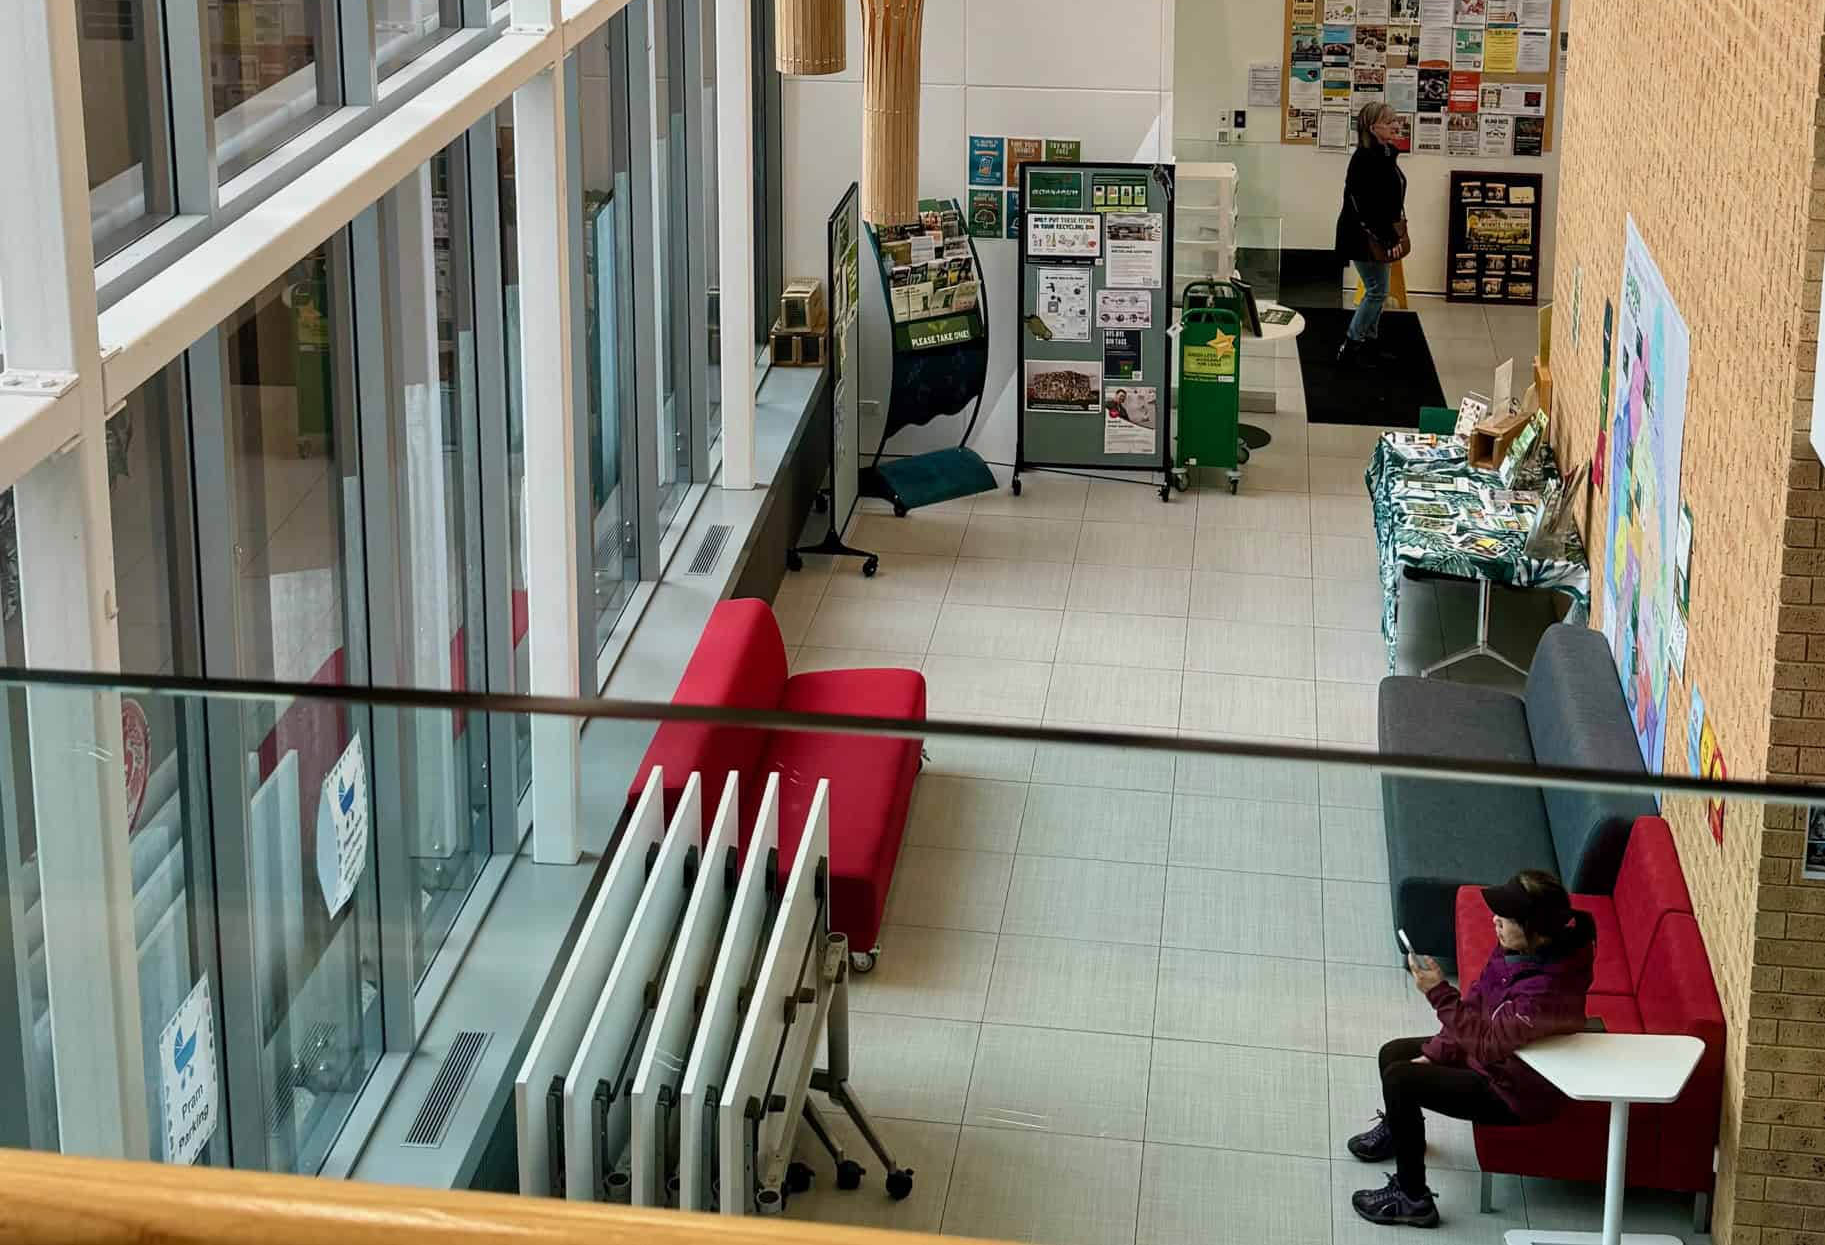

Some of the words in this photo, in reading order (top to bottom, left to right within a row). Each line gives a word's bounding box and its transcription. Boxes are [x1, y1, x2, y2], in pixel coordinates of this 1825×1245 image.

[912, 335, 937, 348] PLEASE
[937, 332, 953, 343] TAKE
[181, 1084, 204, 1119] Pram
[178, 1103, 209, 1155] Parking
